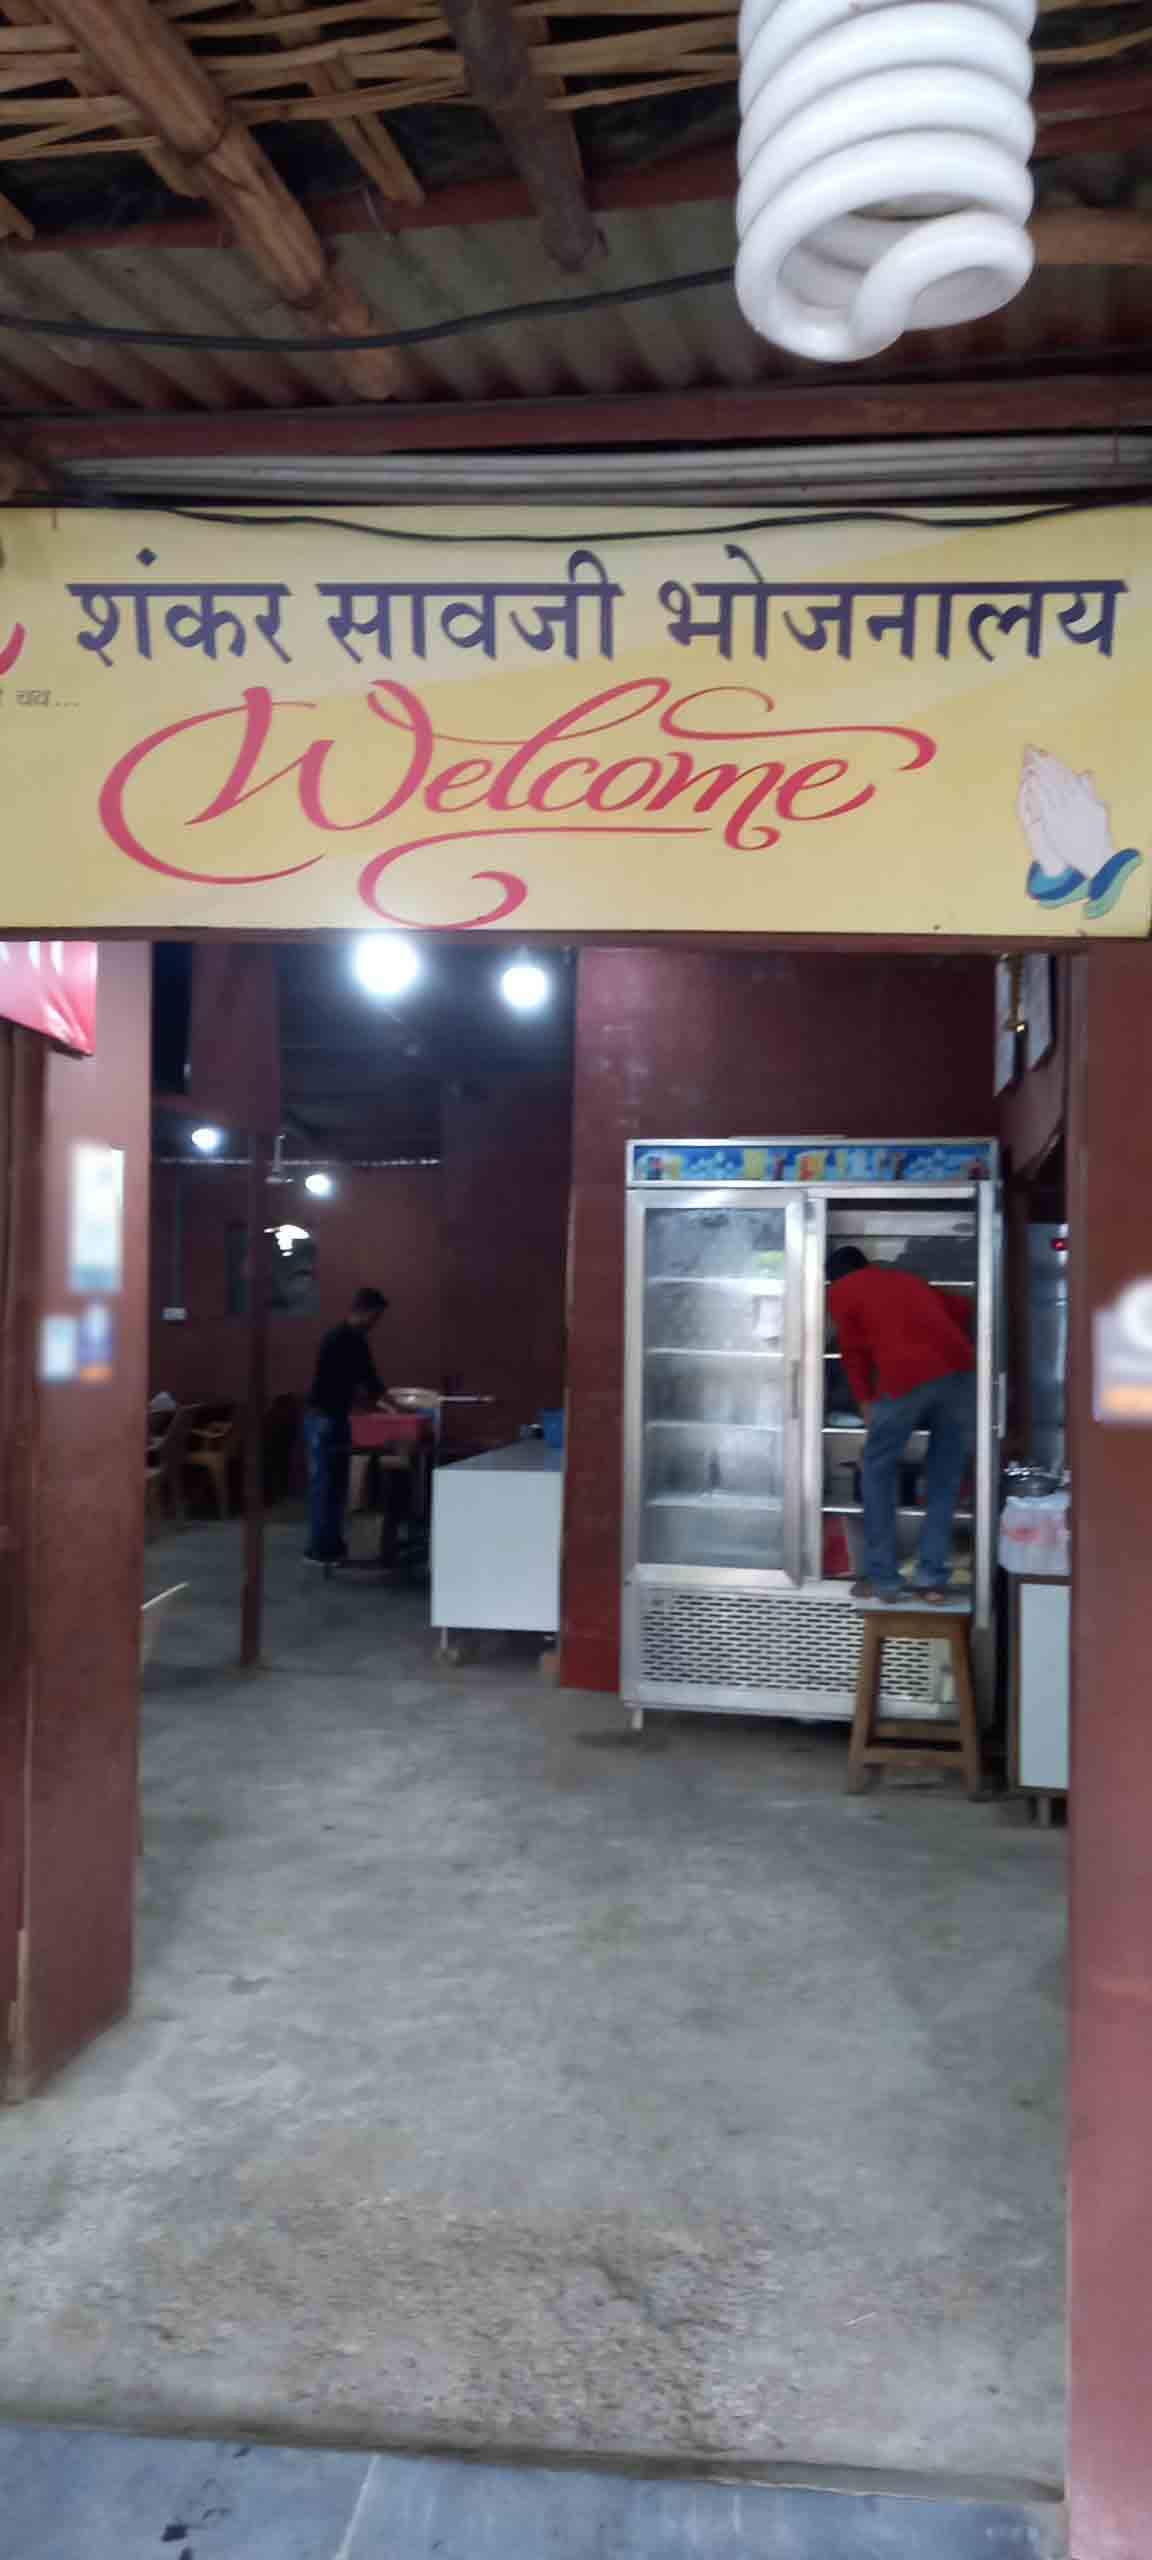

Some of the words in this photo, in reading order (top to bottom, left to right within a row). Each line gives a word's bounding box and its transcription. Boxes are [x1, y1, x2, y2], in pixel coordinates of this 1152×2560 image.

[66, 547, 293, 667] शंकर
[316, 549, 624, 662] सावजी
[658, 544, 1128, 661] भोजनालय
[98, 677, 937, 930] Welcome
